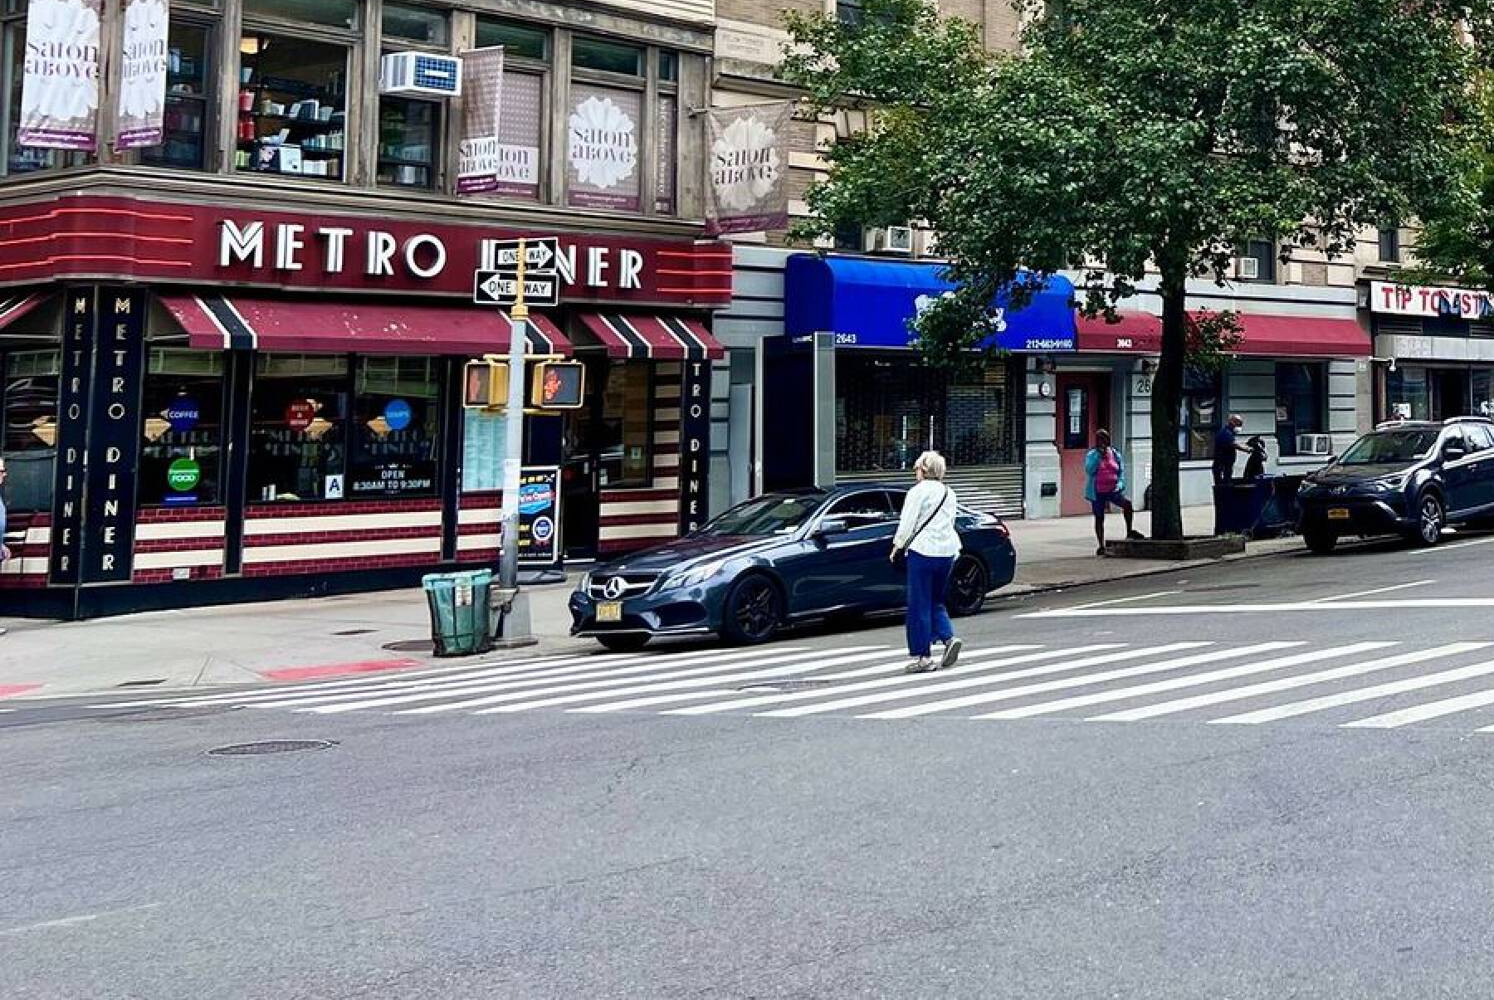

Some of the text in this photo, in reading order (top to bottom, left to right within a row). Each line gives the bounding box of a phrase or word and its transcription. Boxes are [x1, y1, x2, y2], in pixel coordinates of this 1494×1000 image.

[218, 219, 643, 289] METRO NER
[528, 249, 548, 262] WAY
[488, 280, 547, 295] ONE WAY
[1381, 287, 1412, 310] TIP
[60, 297, 87, 571] METRO DINER
[101, 297, 131, 571] METRO DINER
[688, 362, 702, 532] TRO DINER
[328, 477, 341, 492] A
[381, 470, 405, 480] OPEN
[387, 481, 399, 490] TO
